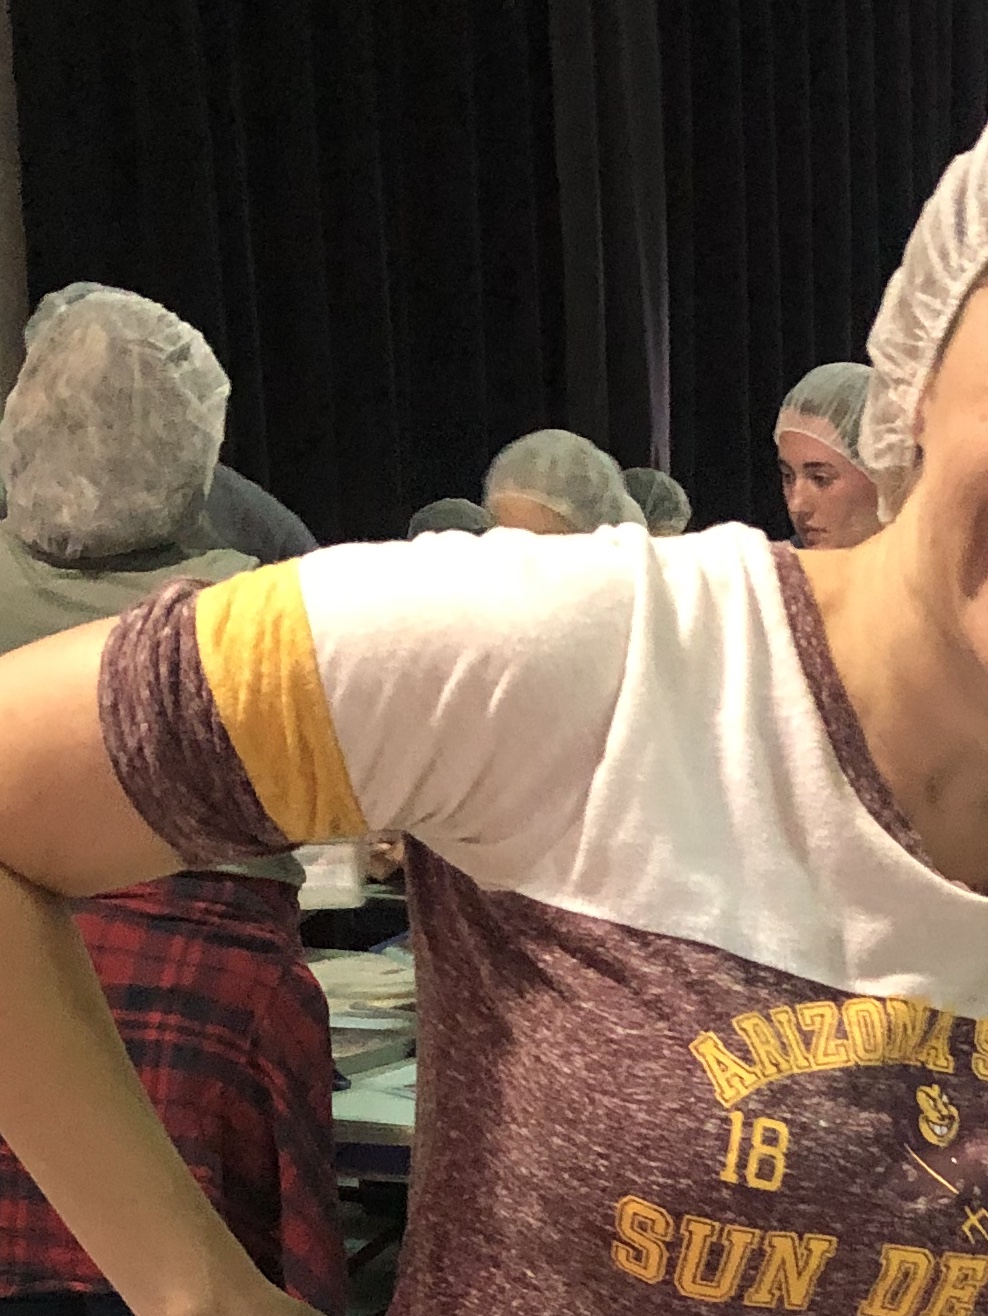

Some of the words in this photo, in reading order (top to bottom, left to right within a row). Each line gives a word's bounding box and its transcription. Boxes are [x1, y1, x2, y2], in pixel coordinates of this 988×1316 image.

[690, 997, 956, 1106] ARIZONA
[721, 1111, 789, 1191] 18
[612, 1195, 838, 1309] SUN
